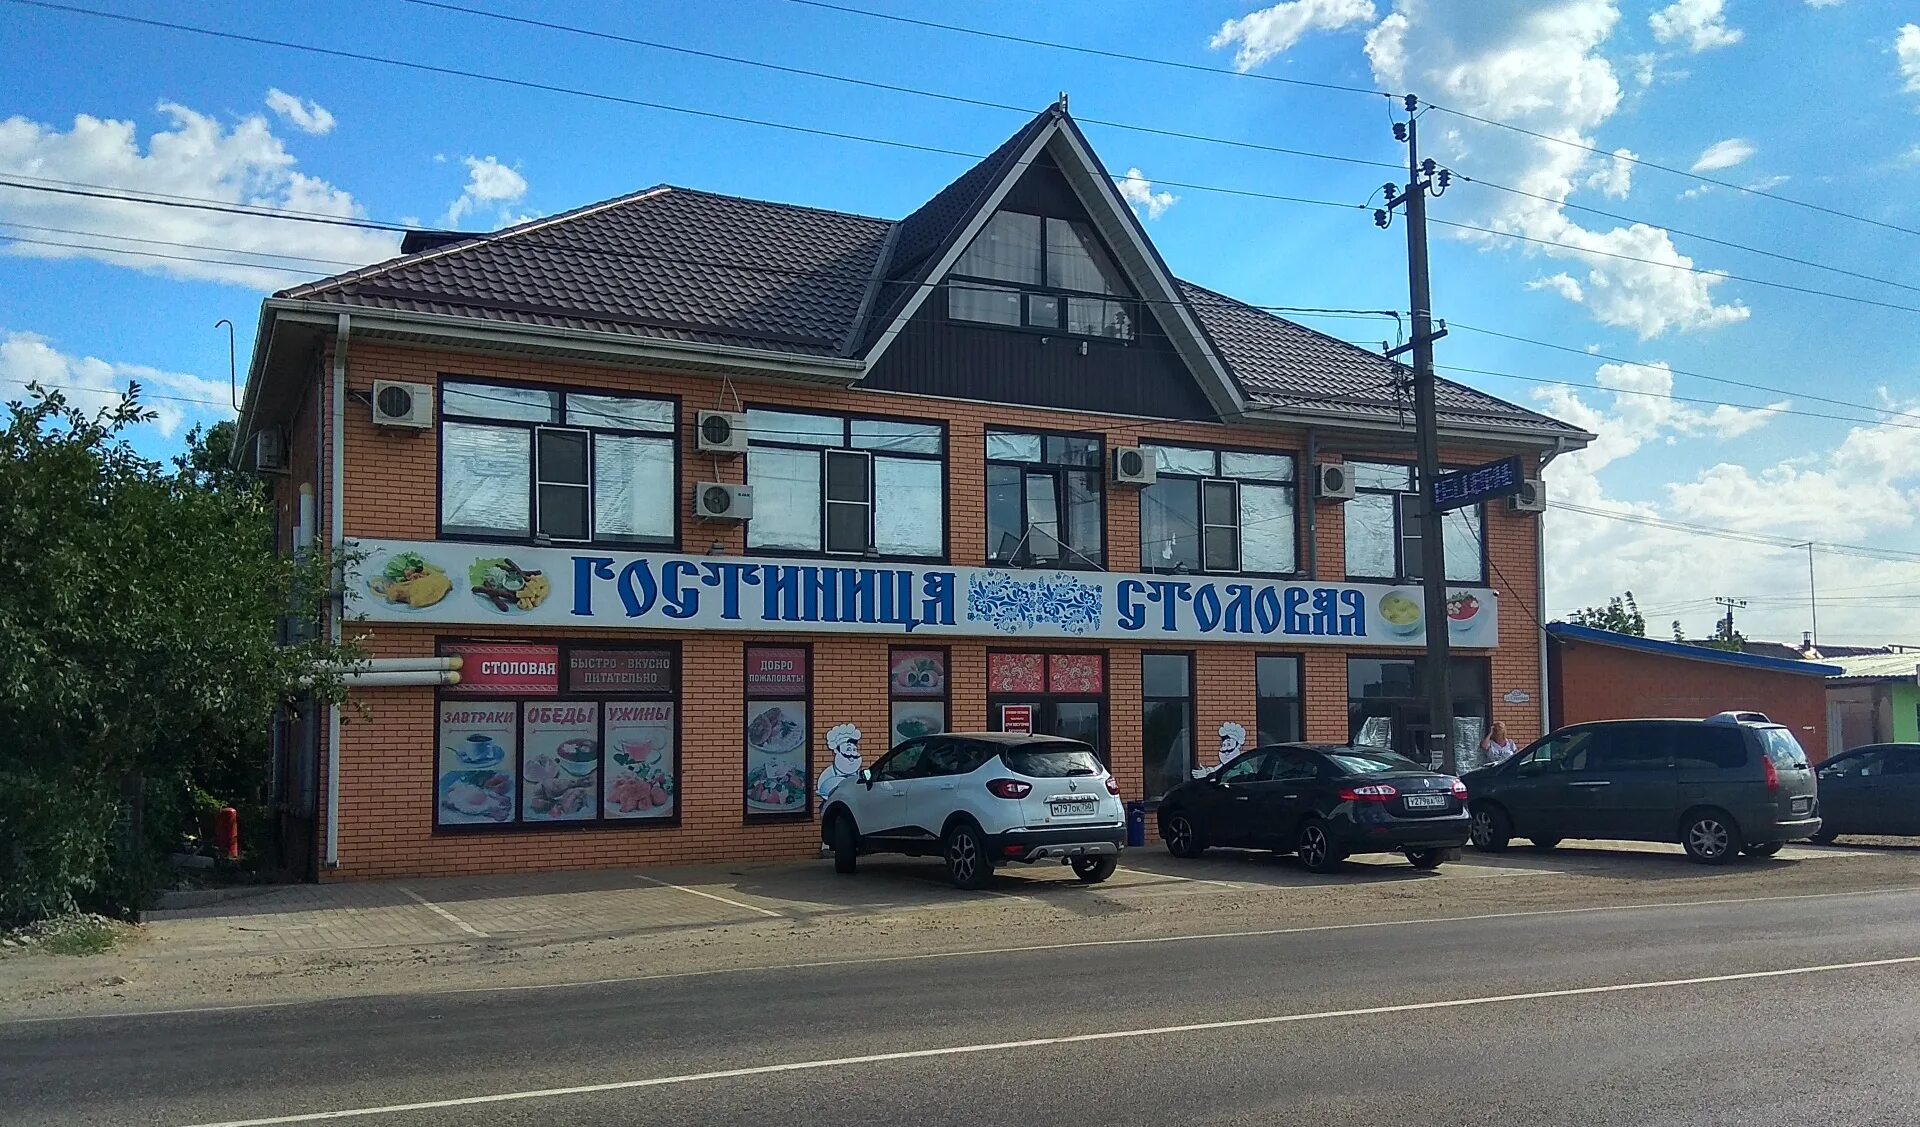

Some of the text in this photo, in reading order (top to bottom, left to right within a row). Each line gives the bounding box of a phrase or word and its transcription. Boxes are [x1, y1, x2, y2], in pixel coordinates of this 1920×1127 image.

[571, 556, 957, 632] ГОСТИНИЦА
[1117, 579, 1368, 637] СТОЛОВАЯ
[481, 661, 556, 675] СТОЛОВАЯ
[570, 658, 617, 669] БЫСТРО
[627, 658, 670, 669] ВКУСНО
[760, 660, 793, 671] ДОБРО
[584, 672, 657, 684] ПИТАТЕЛЬНО
[749, 674, 804, 683] ПОЖАЛОВАТЬ!
[443, 711, 514, 724] ЗАВТРАКИ
[527, 707, 595, 725] ОБЕДЫ
[608, 707, 672, 722] УЖИНЫ
